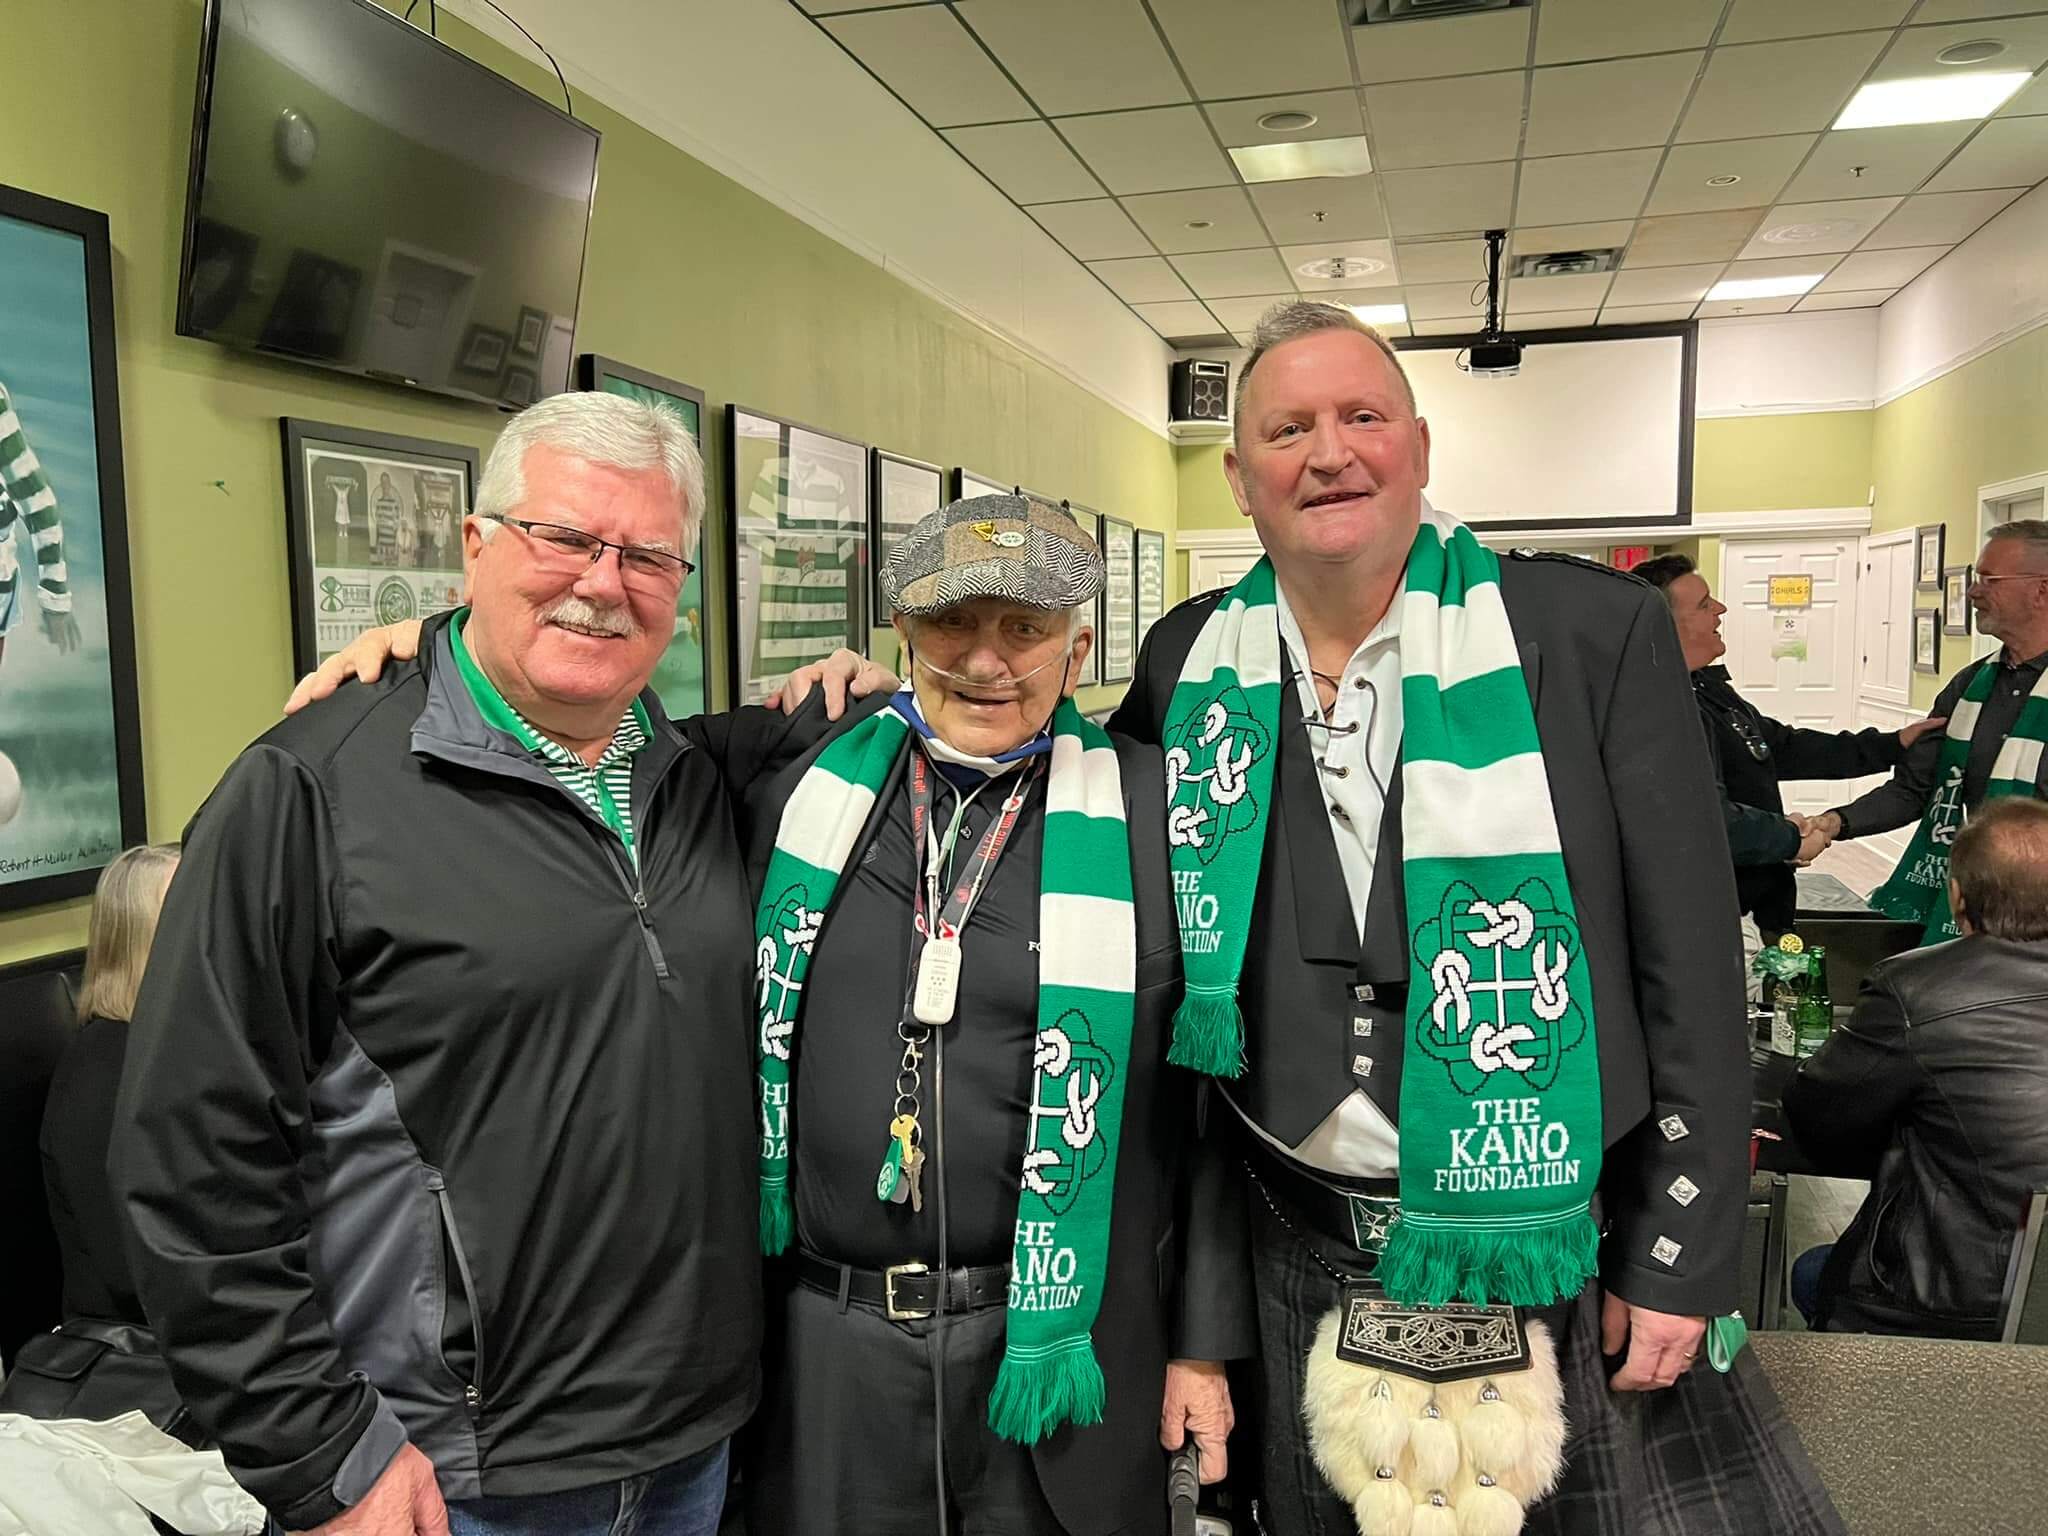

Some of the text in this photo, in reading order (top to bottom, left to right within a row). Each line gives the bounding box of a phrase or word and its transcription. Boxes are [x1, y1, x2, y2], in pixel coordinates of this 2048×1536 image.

[1172, 871, 1203, 893] HE
[1914, 860, 1951, 880] KAN
[1175, 894, 1219, 929] NO
[1472, 1097, 1541, 1126] THE
[1449, 1122, 1570, 1168] KANO
[1433, 1159, 1581, 1193] FOUNDATION
[1014, 1219, 1057, 1246] HE
[1010, 1245, 1077, 1285] NO
[1007, 1285, 1084, 1311] DATION
